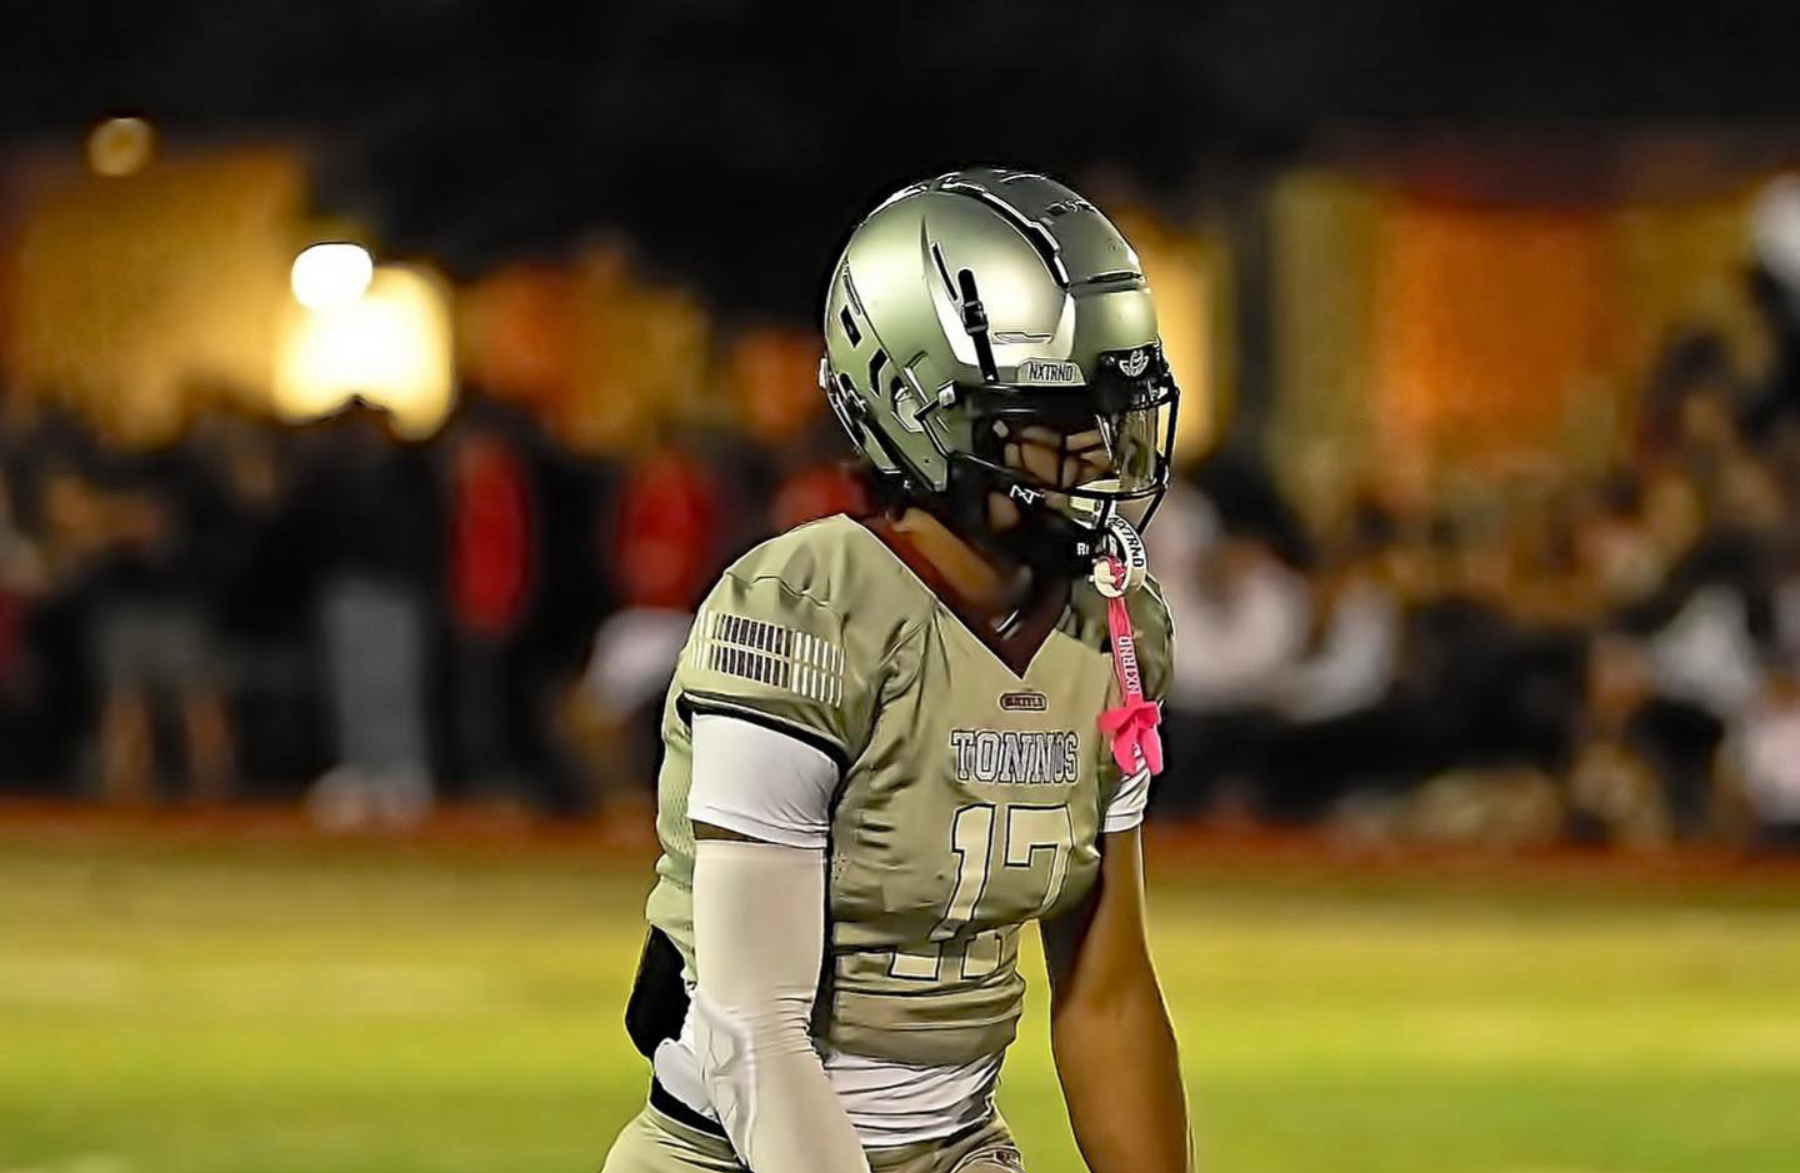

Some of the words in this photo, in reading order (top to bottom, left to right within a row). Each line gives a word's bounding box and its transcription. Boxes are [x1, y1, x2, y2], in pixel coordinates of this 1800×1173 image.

[1029, 362, 1073, 381] NXTRND
[1118, 636, 1142, 694] NXTRND
[889, 802, 1074, 980] 17
